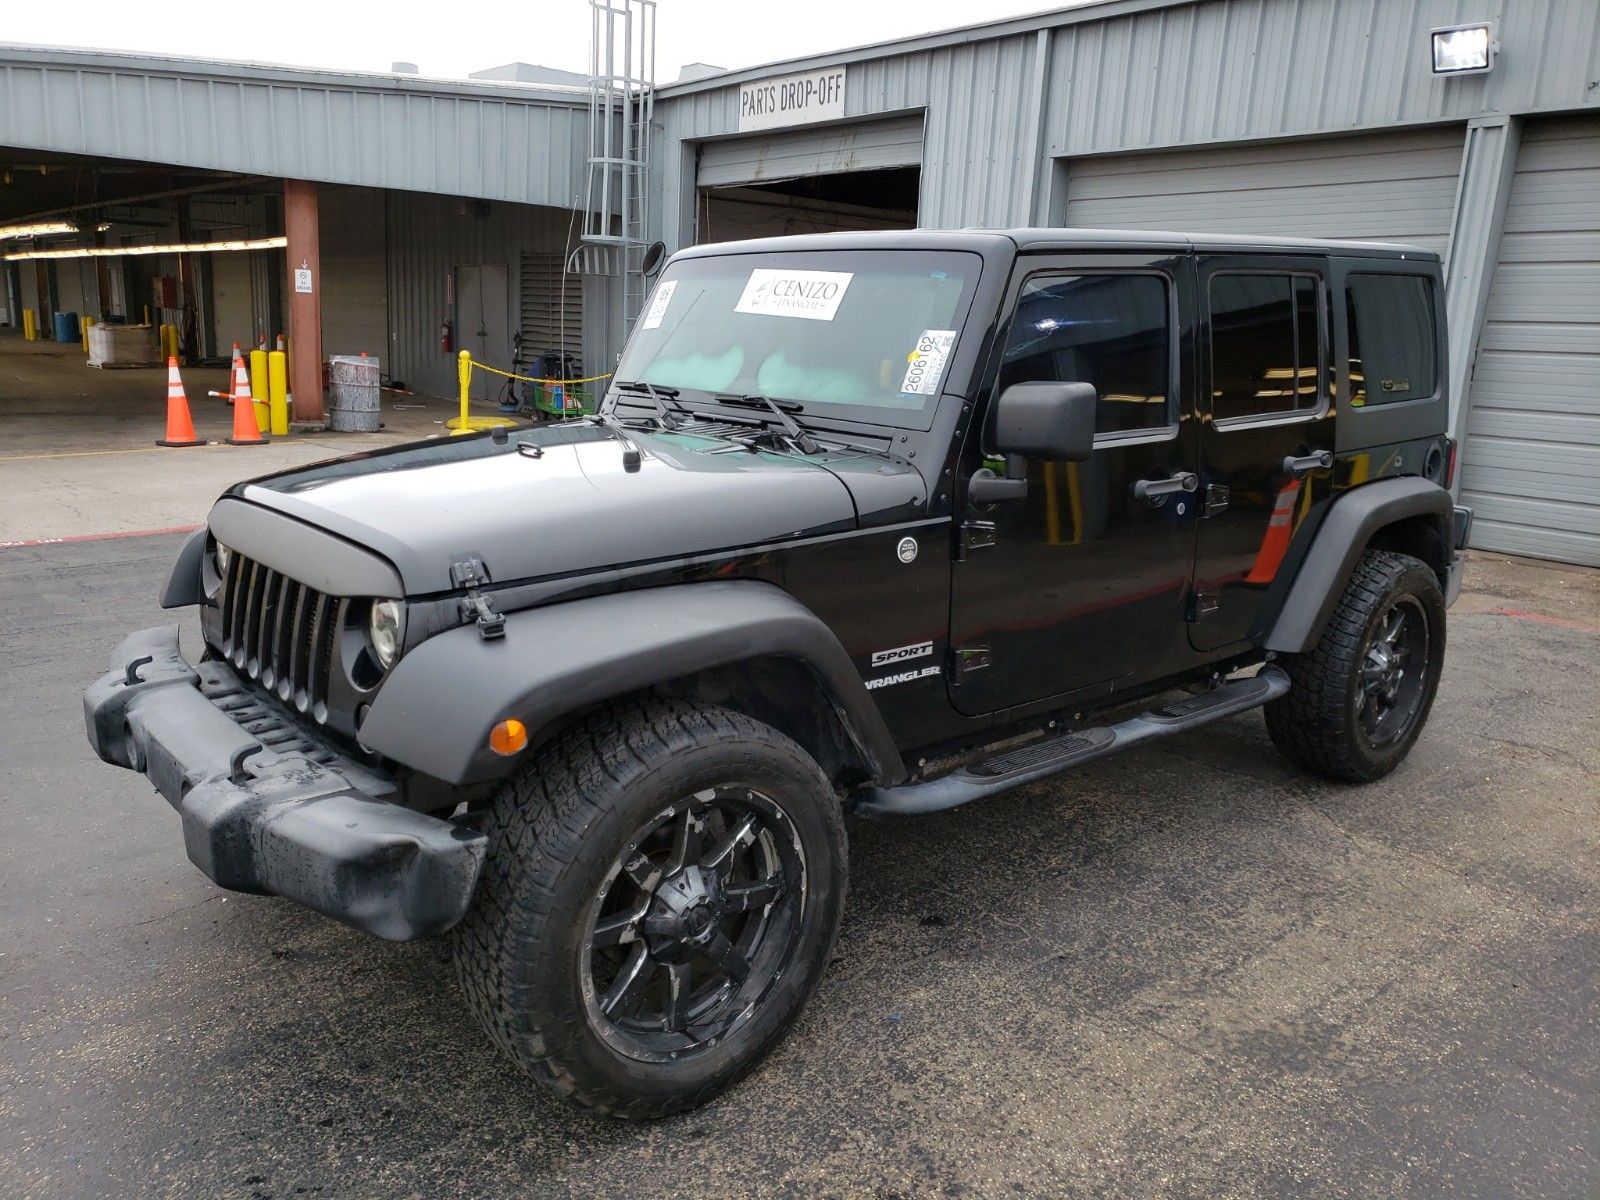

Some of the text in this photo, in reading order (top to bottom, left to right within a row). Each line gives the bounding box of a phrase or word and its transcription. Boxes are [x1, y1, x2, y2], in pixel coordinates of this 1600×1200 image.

[742, 73, 843, 117] PARTS DROP-OFF
[773, 279, 839, 300] CENIZO
[904, 336, 936, 392] 2606162
[875, 645, 928, 663] SPORT
